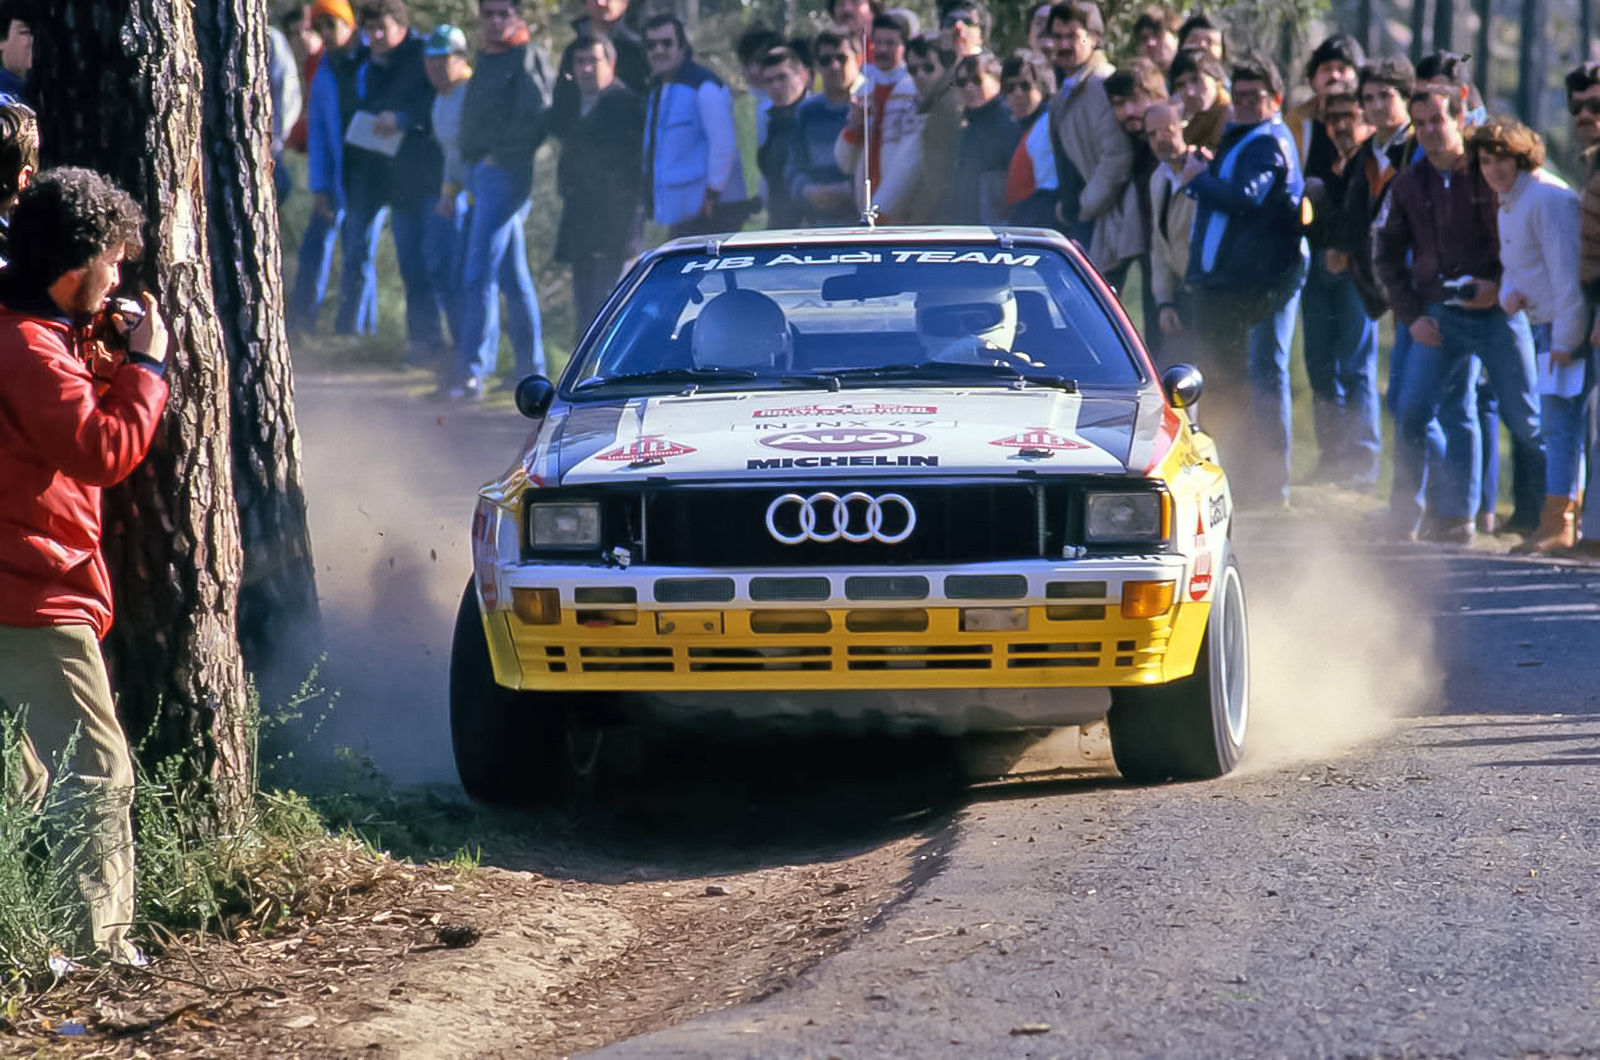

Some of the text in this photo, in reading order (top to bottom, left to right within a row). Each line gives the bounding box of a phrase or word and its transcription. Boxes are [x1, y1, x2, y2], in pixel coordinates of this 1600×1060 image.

[681, 256, 754, 273] HB
[892, 250, 1041, 267] TEAM
[747, 455, 939, 469] MICHELIN
